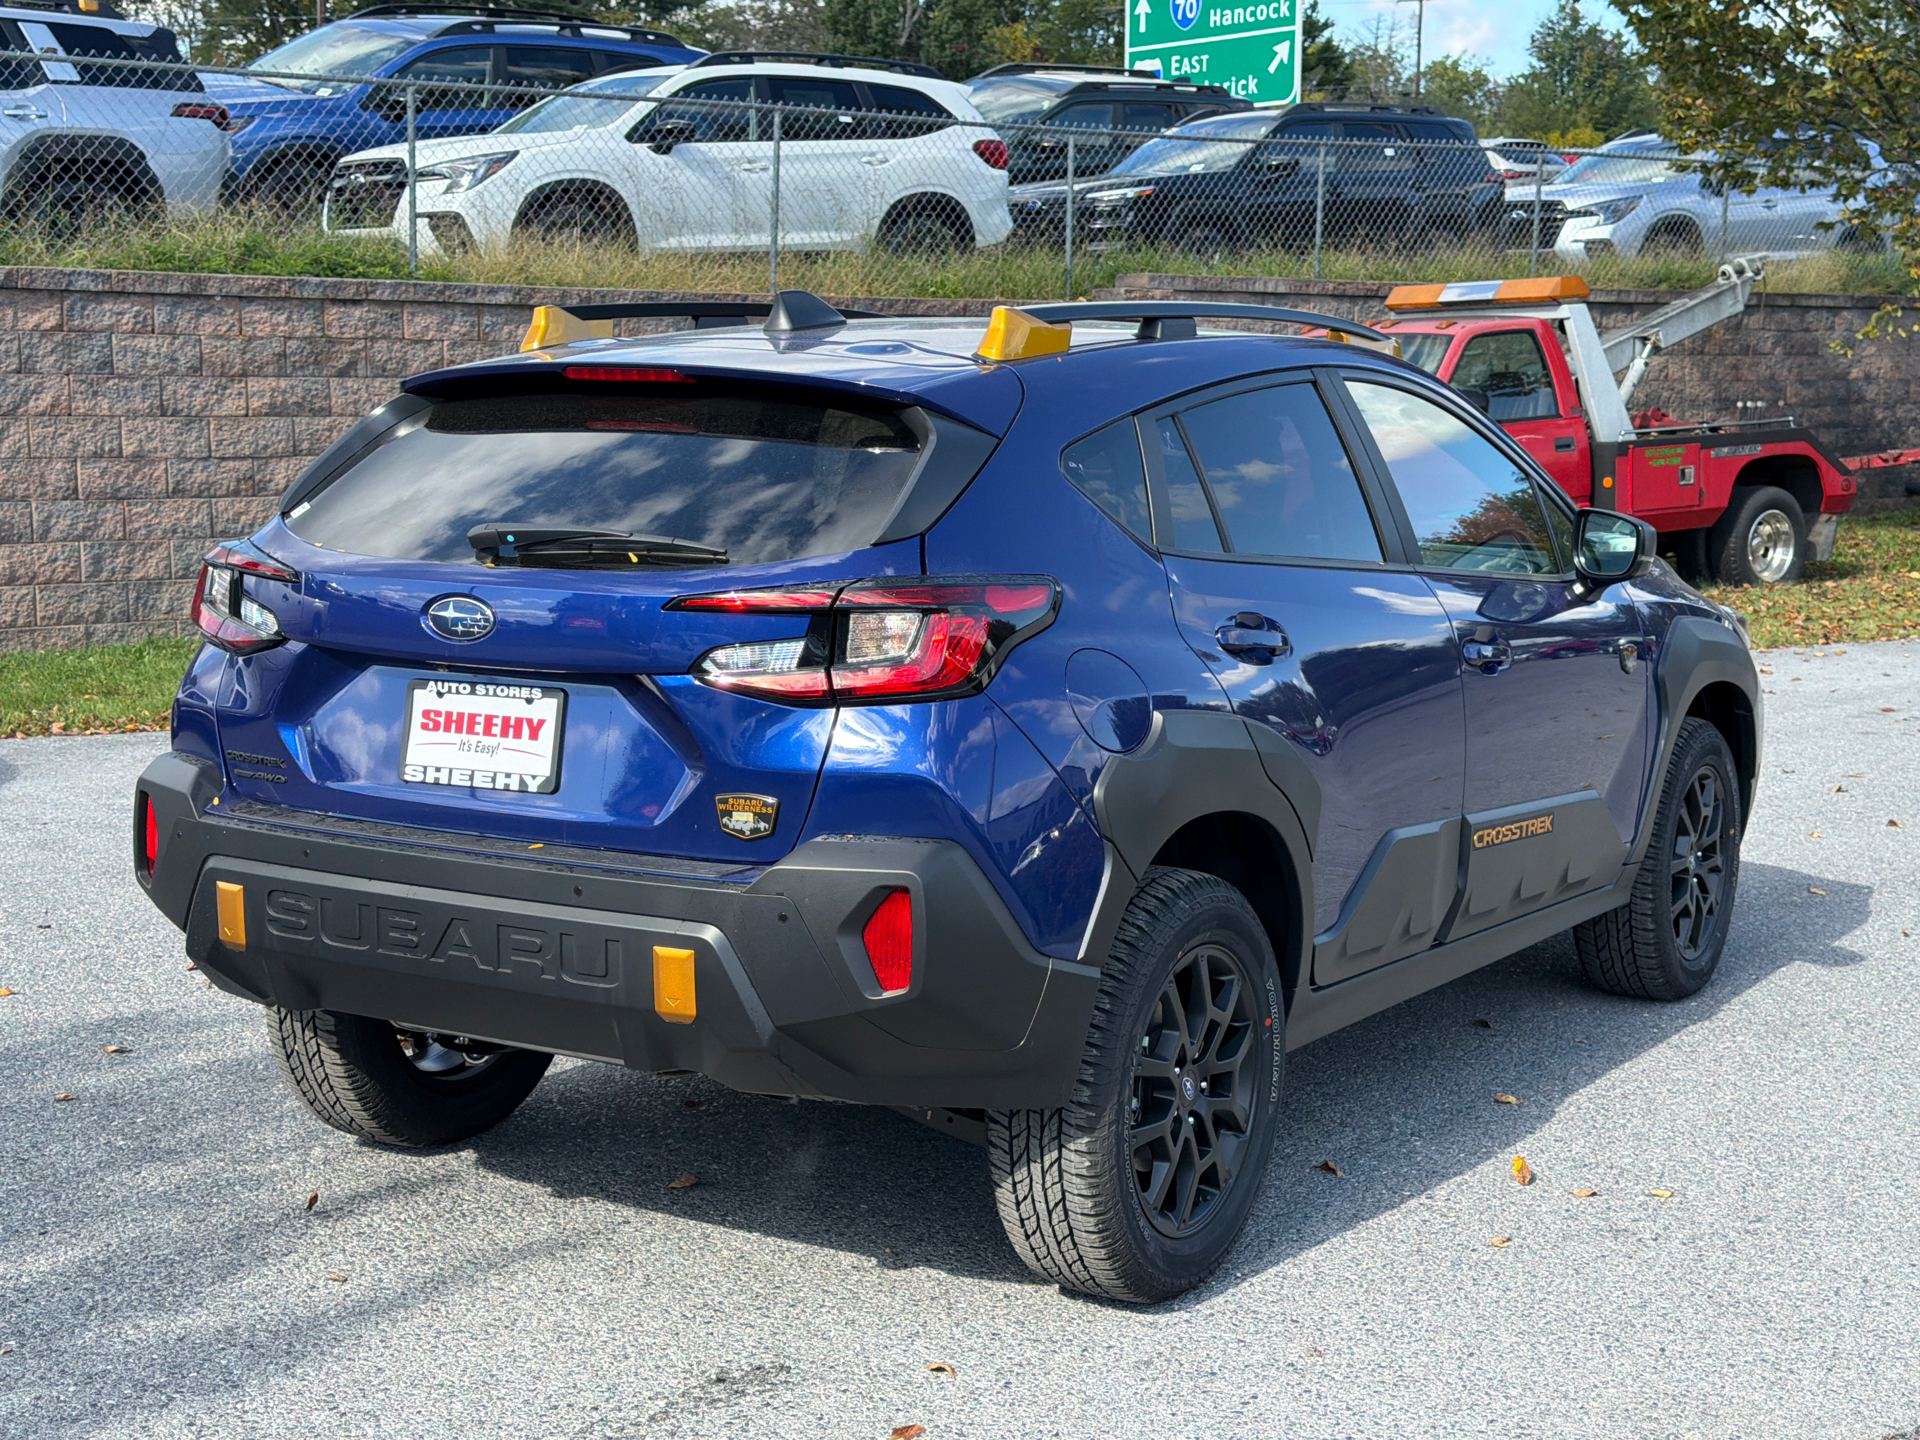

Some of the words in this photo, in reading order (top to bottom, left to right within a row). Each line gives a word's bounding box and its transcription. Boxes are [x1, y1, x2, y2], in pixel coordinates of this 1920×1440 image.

[1176, 0, 1197, 21] 70
[1209, 1, 1290, 28] Hancock
[1171, 55, 1209, 76] EAST
[426, 681, 471, 695] AUTO
[475, 684, 543, 699] STORES
[420, 709, 547, 741] SHEEHY
[458, 739, 473, 753] It's
[475, 741, 501, 758] Easy!
[226, 750, 287, 769] CROSSTREK
[403, 765, 547, 792] SHEEHY
[719, 803, 773, 814] WILDERNESS
[728, 798, 763, 807] SUBARU
[1473, 815, 1553, 849] CROSSTREK
[266, 889, 622, 989] SUBARU
[1265, 978, 1281, 1102] YOKOHAMA
